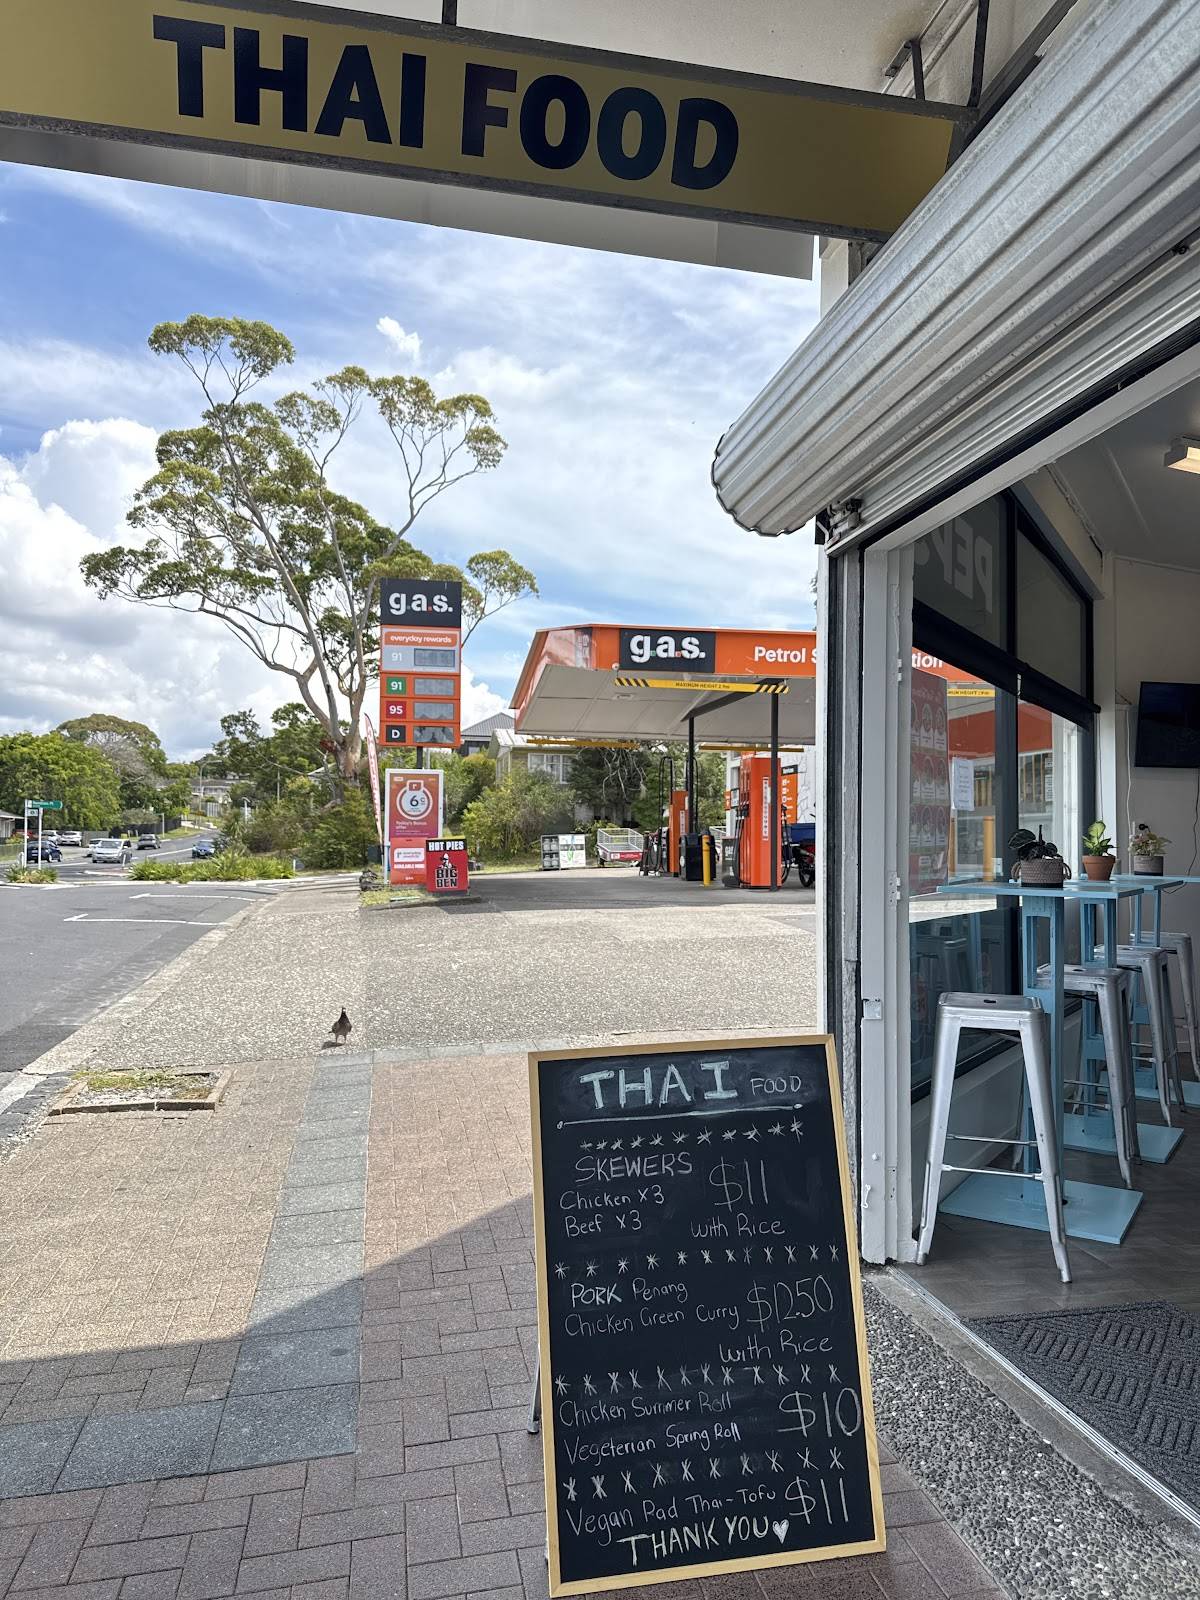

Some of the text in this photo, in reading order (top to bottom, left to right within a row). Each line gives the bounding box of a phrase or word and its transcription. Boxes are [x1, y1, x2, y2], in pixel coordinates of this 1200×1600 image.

[153, 14, 739, 190] THAI FOOD
[390, 635, 422, 643] everyday
[754, 646, 806, 663] Petrol
[391, 652, 402, 662] 91
[390, 681, 402, 691] 91
[389, 705, 403, 715] 95
[391, 729, 401, 739] D
[428, 841, 465, 851] HOT PIES
[436, 868, 458, 878] BIG
[436, 878, 458, 888] BEN
[579, 1059, 802, 1110] THAI FOOD
[575, 1151, 693, 1183] SKEWERS
[708, 1155, 769, 1213] $11
[559, 1190, 631, 1211] Chicken
[565, 1214, 604, 1237] Beef
[690, 1212, 786, 1239] with Rice
[570, 1277, 688, 1308] PORK Penang
[564, 1303, 740, 1337] Chicken Green Curry
[719, 1328, 833, 1363] with Rice
[559, 1399, 626, 1427] Chicken
[698, 1390, 732, 1413] Roll
[777, 1386, 862, 1438] $10
[665, 1423, 710, 1452] Spring
[714, 1421, 743, 1442] Roll
[784, 1474, 850, 1526] $11
[564, 1507, 634, 1547] Vegan
[642, 1498, 679, 1523] Pad
[616, 1514, 769, 1567] THANK YOU
